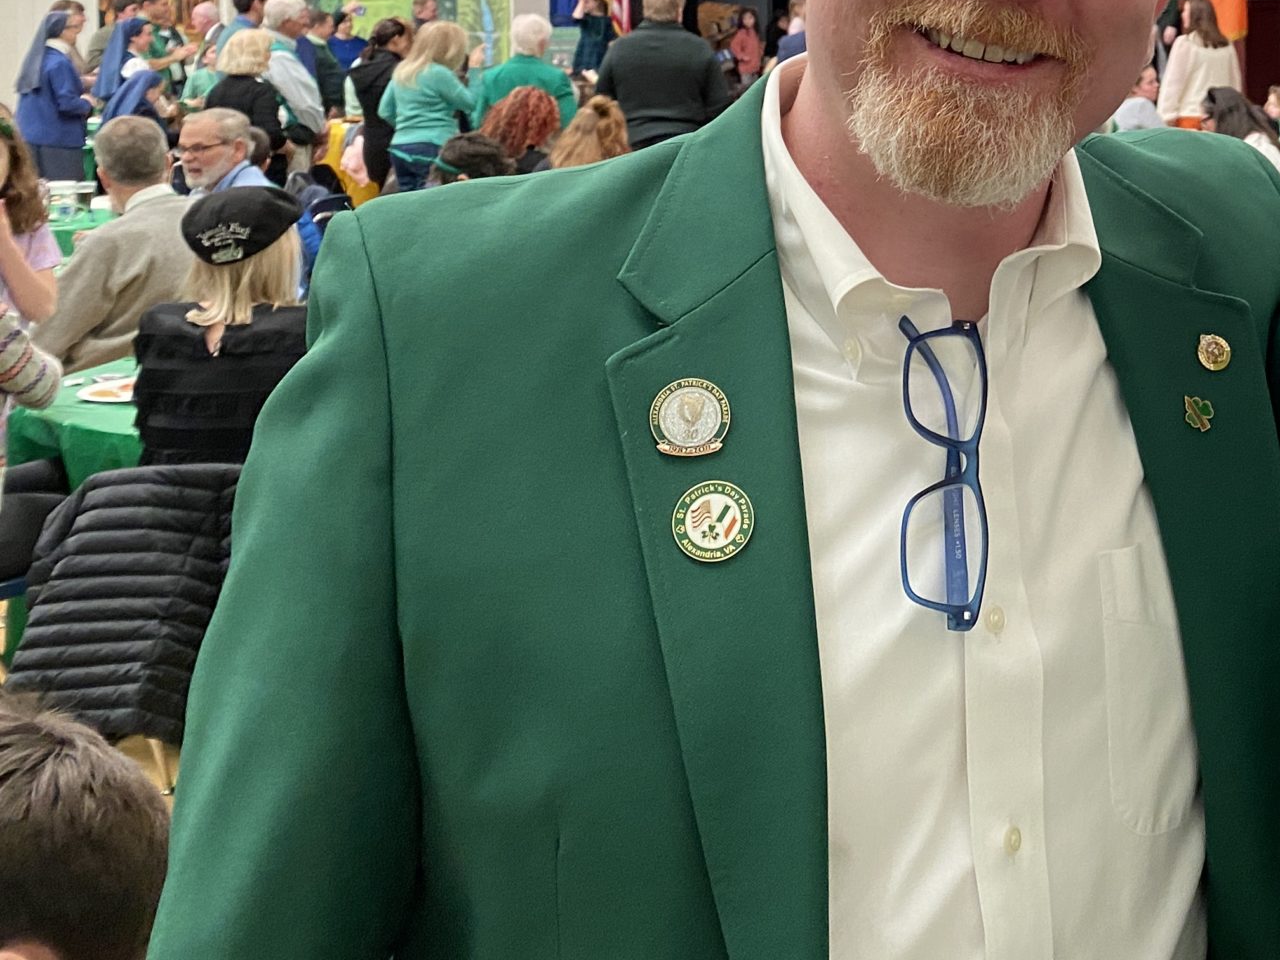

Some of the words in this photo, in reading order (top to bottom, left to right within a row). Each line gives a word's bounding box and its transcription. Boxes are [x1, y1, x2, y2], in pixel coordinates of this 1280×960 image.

[652, 390, 671, 425] ALEXANDRIA
[681, 380, 712, 391] PATRICK'S
[676, 507, 686, 519] St.
[684, 484, 722, 505] Patrick's
[724, 486, 739, 500] Day
[738, 498, 750, 529] Parade
[681, 539, 724, 558] Alexandria,
[723, 544, 736, 554] VA
